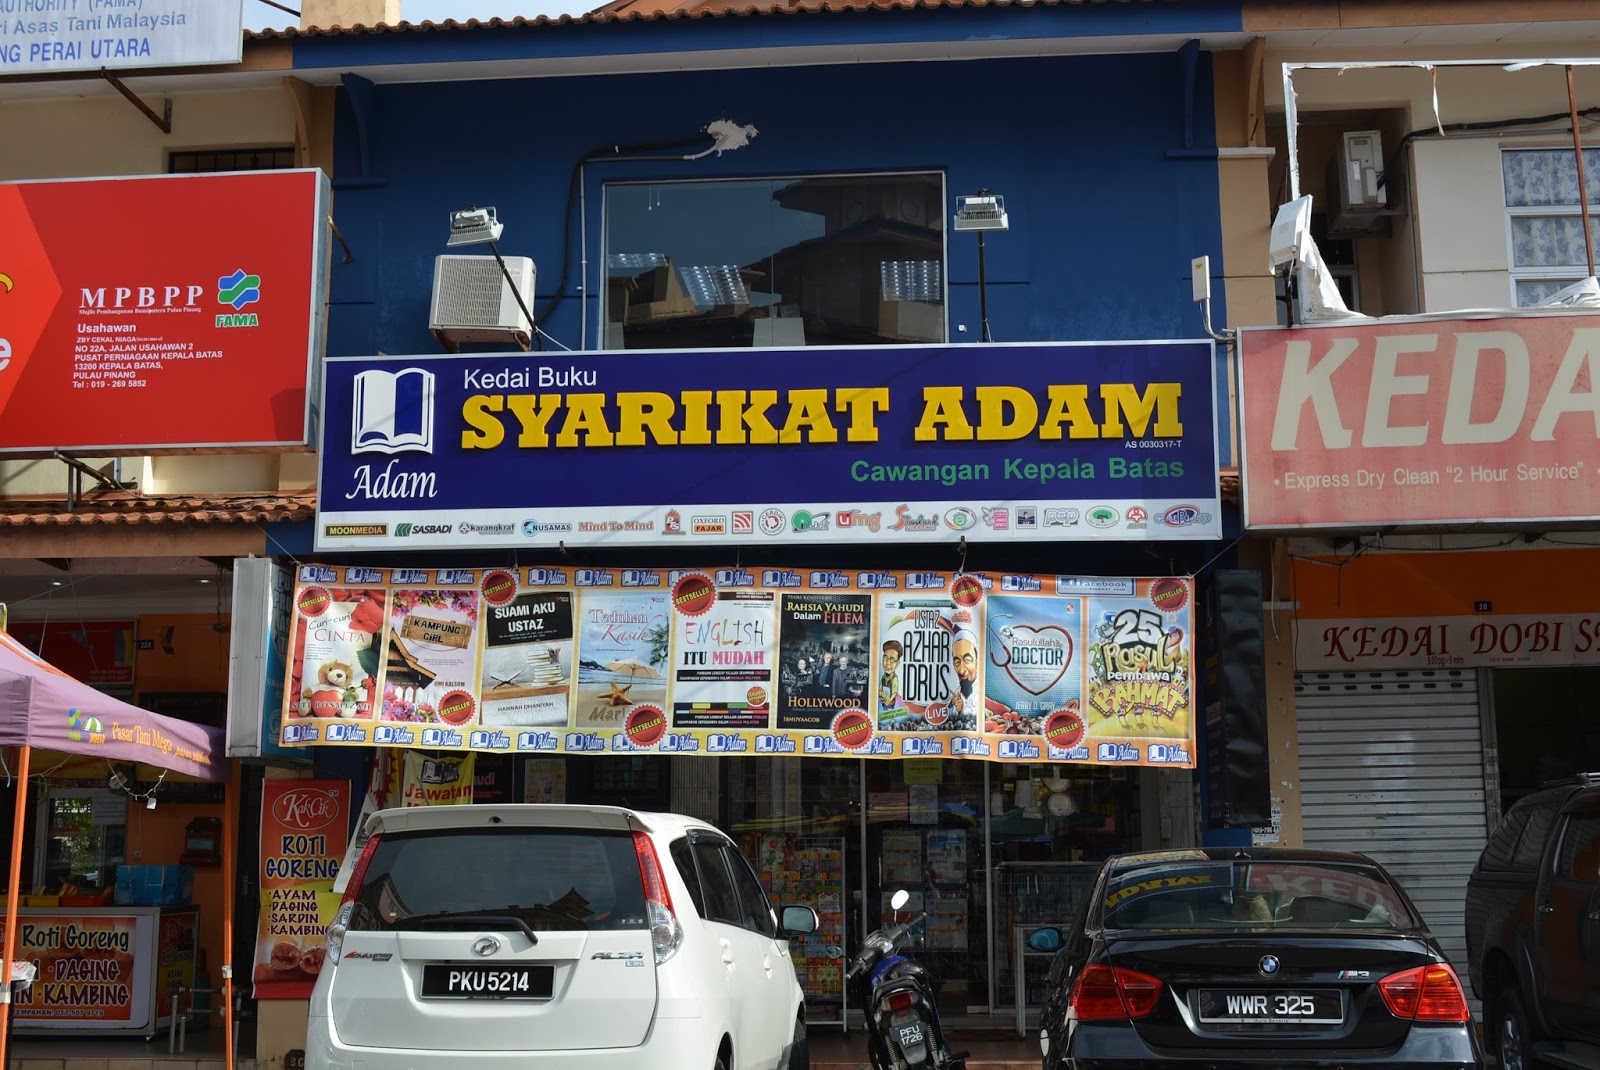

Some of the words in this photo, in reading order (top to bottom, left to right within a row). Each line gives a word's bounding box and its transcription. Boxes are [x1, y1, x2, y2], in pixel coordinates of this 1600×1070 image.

[13, 20, 59, 35] Asas
[67, 15, 101, 31] Tani
[107, 11, 187, 30] Malaysia
[30, 41, 82, 62] PERAI
[91, 37, 151, 59] UTARA
[77, 323, 137, 333] Usahawan
[215, 313, 259, 328] FAMA
[75, 345, 88, 353] NO
[89, 345, 107, 353] 22A,
[109, 344, 137, 352] JALAN
[139, 343, 187, 351] USAHAWAN
[103, 353, 160, 361] PERNIAGAAN
[161, 352, 194, 360] KEPALA
[99, 362, 132, 370] KEPALA
[133, 361, 163, 369] BATAS,
[103, 371, 136, 379] PINANG
[463, 368, 531, 389] Kedai
[538, 366, 597, 388] Buku
[91, 380, 105, 388] 019
[112, 380, 126, 388] 269
[128, 379, 147, 387] 5852
[461, 387, 890, 450] SYARIKAT
[914, 382, 1184, 442] ADAM
[1124, 441, 1138, 449] AS
[1139, 440, 1182, 449] 0030317-T
[345, 458, 438, 500] Adam
[850, 458, 990, 486] Cawangan
[1004, 457, 1096, 484] Kepala
[1108, 456, 1185, 479] Batas
[1284, 472, 1350, 490] Express
[1357, 470, 1385, 490] Dry
[1394, 468, 1440, 485] Clean
[1471, 465, 1508, 482] Hour
[470, 523, 516, 532] karangkraf
[532, 523, 573, 532] NUSAMAS
[578, 521, 607, 532] Mind
[609, 521, 623, 531] To
[624, 520, 654, 531] Mind
[693, 517, 725, 525] OXFORD
[329, 526, 384, 536] MOONMEDIA
[411, 524, 453, 535] SASBADI
[410, 568, 429, 584] Adam
[640, 569, 660, 586] Adam
[924, 573, 945, 590] Adam
[484, 581, 511, 595] BESTSELLER
[1153, 588, 1183, 602] BESTSELLER
[675, 587, 710, 606] BESTSELLER
[495, 605, 530, 619] SUAMI
[533, 602, 555, 614] AKU
[787, 602, 823, 612] RAHSIA
[825, 602, 864, 612] YAHUDI
[1478, 602, 1488, 611] 20
[308, 612, 350, 630] Curi-curi
[588, 609, 648, 623] Teduhan
[794, 612, 822, 620] Dalam
[823, 611, 864, 624] FILEM
[914, 609, 940, 629] USTAZ
[413, 619, 460, 634] KAMPUNG
[508, 619, 544, 632] USTAZ
[685, 618, 765, 647] ENGLISH
[1113, 610, 1162, 645] 25
[314, 628, 365, 644] CINTA
[1012, 636, 1055, 648] Rasulullah
[1322, 624, 1449, 663] KEDAI
[1469, 621, 1564, 655] DOBI
[903, 630, 950, 662] AZHAR
[683, 651, 707, 665] ITU
[711, 651, 765, 665] MUDAH
[1012, 646, 1063, 666] DOCTOR
[903, 663, 950, 701] IDRUS
[1107, 671, 1170, 682] pembawa
[788, 696, 861, 708] HOLLYWOOD
[1015, 701, 1032, 710] JERRY
[1040, 702, 1055, 710] GRAY
[1093, 681, 1186, 716] RAHMAT
[440, 702, 471, 716] BESTSELLER
[927, 707, 947, 719] LIVE
[628, 717, 661, 735] BESTSELLER
[836, 722, 867, 739] BESTSELLER
[1047, 722, 1079, 739] BESTSELLER
[112, 722, 134, 742] Pasar
[134, 725, 151, 745] Tani
[153, 729, 173, 755] Mega
[536, 730, 558, 750] Adam
[774, 735, 796, 753] Adam
[1166, 744, 1189, 763] Adam
[405, 783, 472, 802] Jawatan
[282, 835, 326, 855] ROTI
[266, 858, 340, 879] GORENG
[272, 889, 316, 900] AYAM
[271, 900, 318, 912] DAGING
[271, 913, 319, 924] SARDIN
[22, 924, 61, 947] Roti
[65, 923, 130, 952] Goreng
[56, 959, 120, 981] DAGING
[44, 984, 131, 1005] KAMBING
[1226, 995, 1268, 1015] WWR
[1275, 995, 1315, 1015] 325
[899, 1024, 920, 1038] PFU
[900, 1032, 923, 1046] 1726
